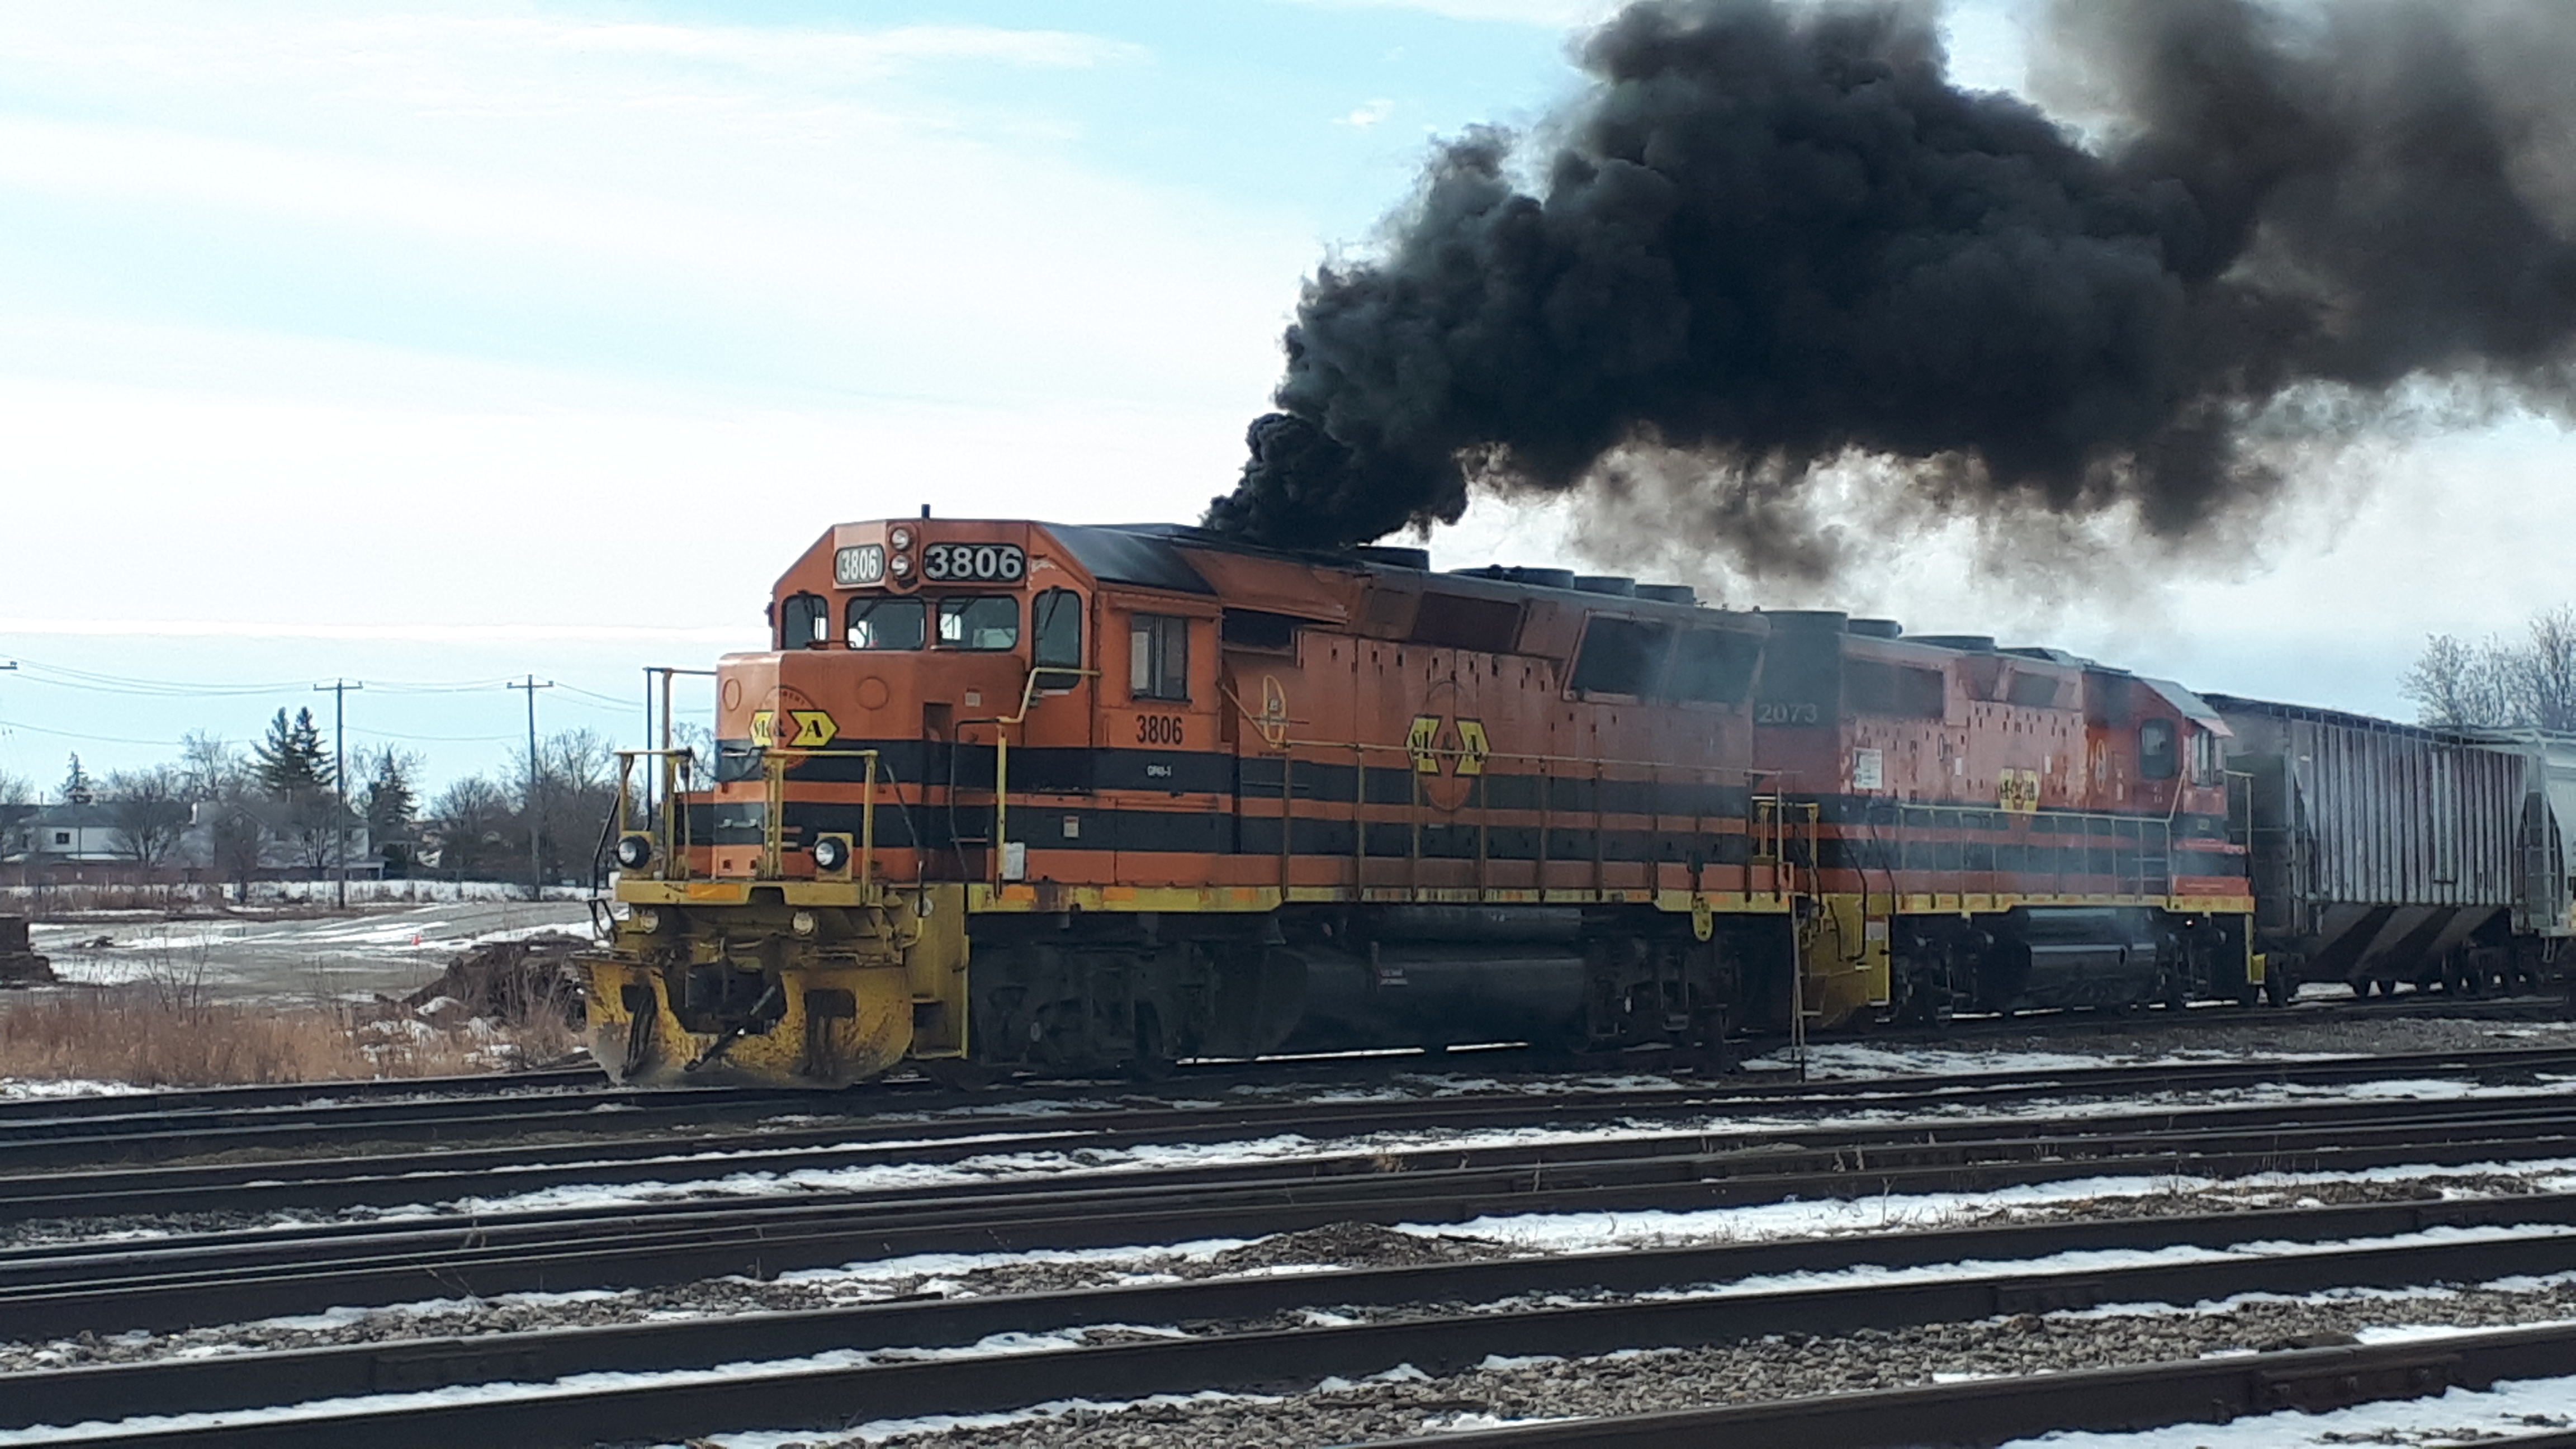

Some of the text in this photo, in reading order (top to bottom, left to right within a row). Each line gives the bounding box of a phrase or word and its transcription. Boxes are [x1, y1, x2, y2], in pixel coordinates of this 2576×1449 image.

[841, 548, 878, 580] 3806
[925, 546, 1022, 578] 3806
[1758, 703, 1817, 723] 2073
[804, 719, 823, 738] A
[1136, 714, 1183, 744] 3806
